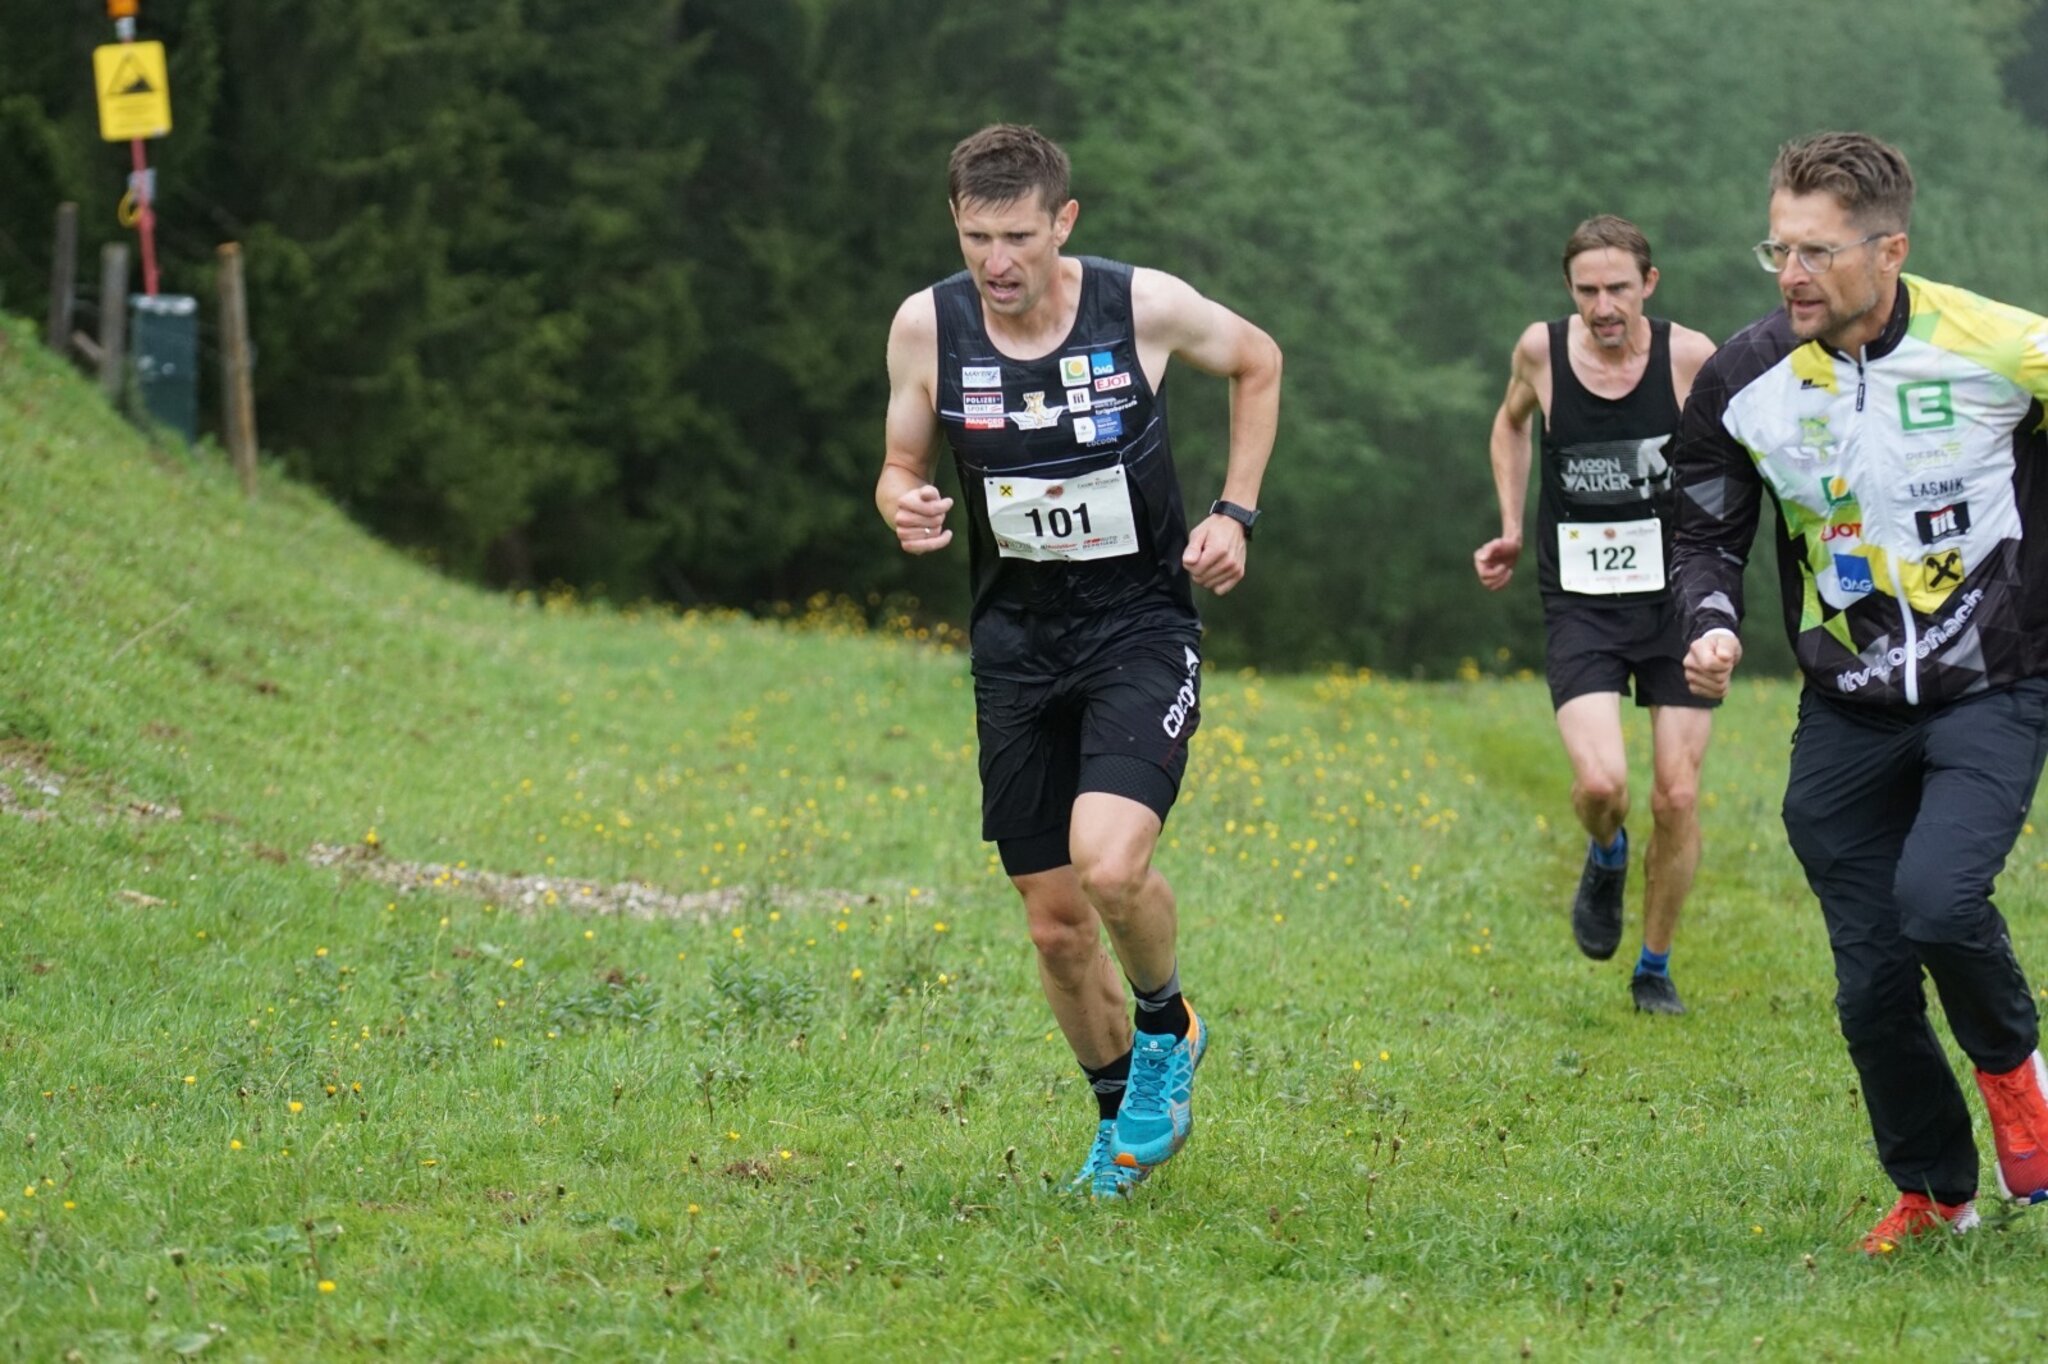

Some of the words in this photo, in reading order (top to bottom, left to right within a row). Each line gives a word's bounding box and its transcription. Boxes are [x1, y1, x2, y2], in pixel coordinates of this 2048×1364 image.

[1097, 375, 1128, 390] EJOT
[1567, 457, 1622, 481] MOON
[1560, 472, 1634, 492] WALKER
[1909, 477, 1965, 498] LASNIK
[1025, 503, 1092, 538] 101
[1587, 546, 1638, 571] 122
